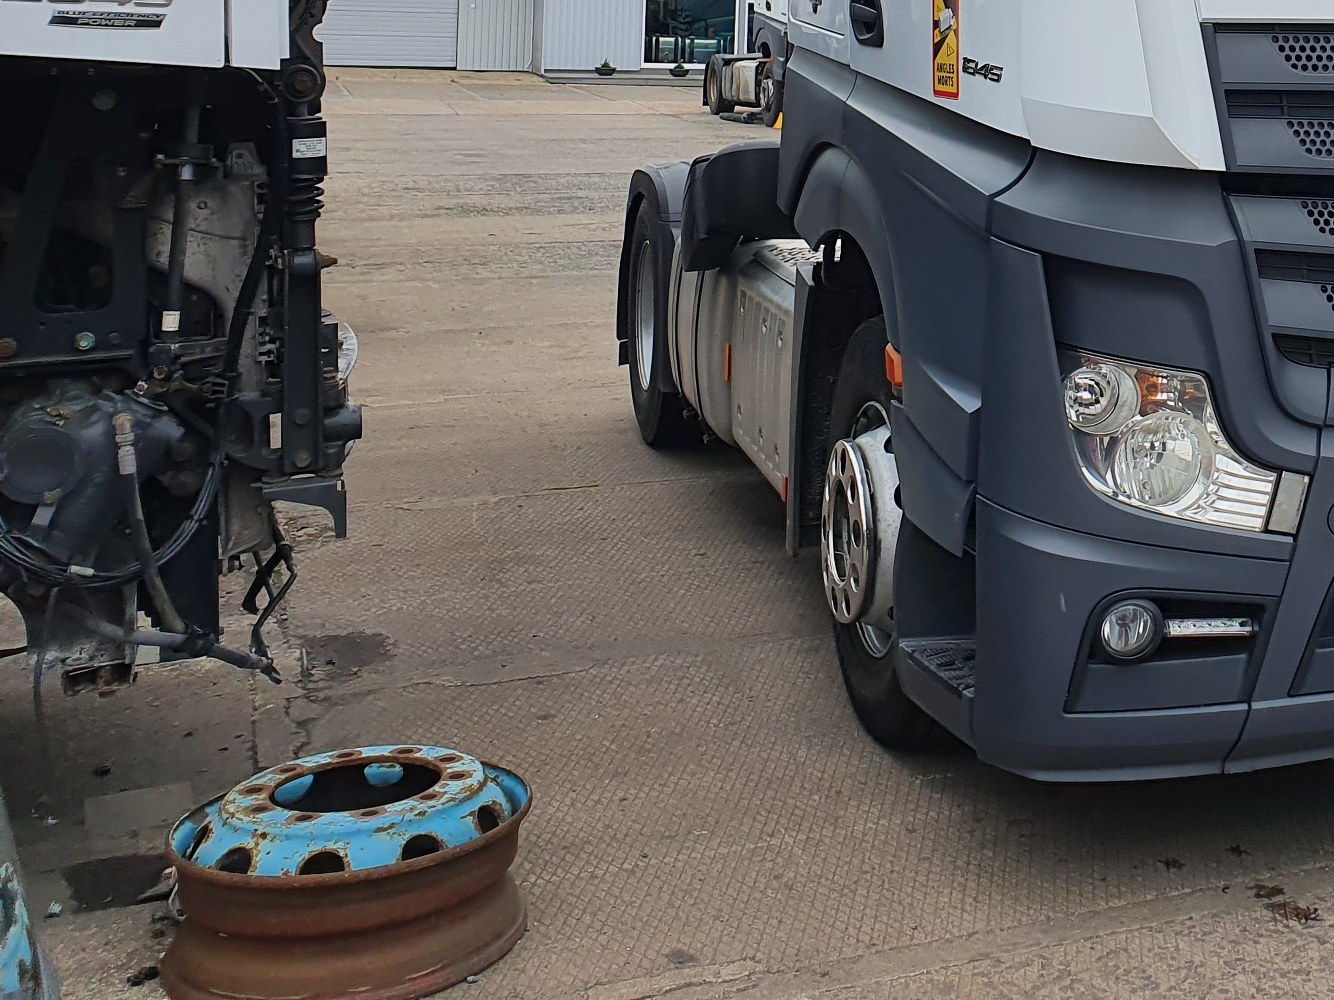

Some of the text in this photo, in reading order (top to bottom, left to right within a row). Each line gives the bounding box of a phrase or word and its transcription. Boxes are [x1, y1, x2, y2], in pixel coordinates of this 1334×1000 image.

[78, 18, 136, 26] POWER
[936, 62, 954, 74] ANGLES
[938, 75, 954, 88] MORTS
